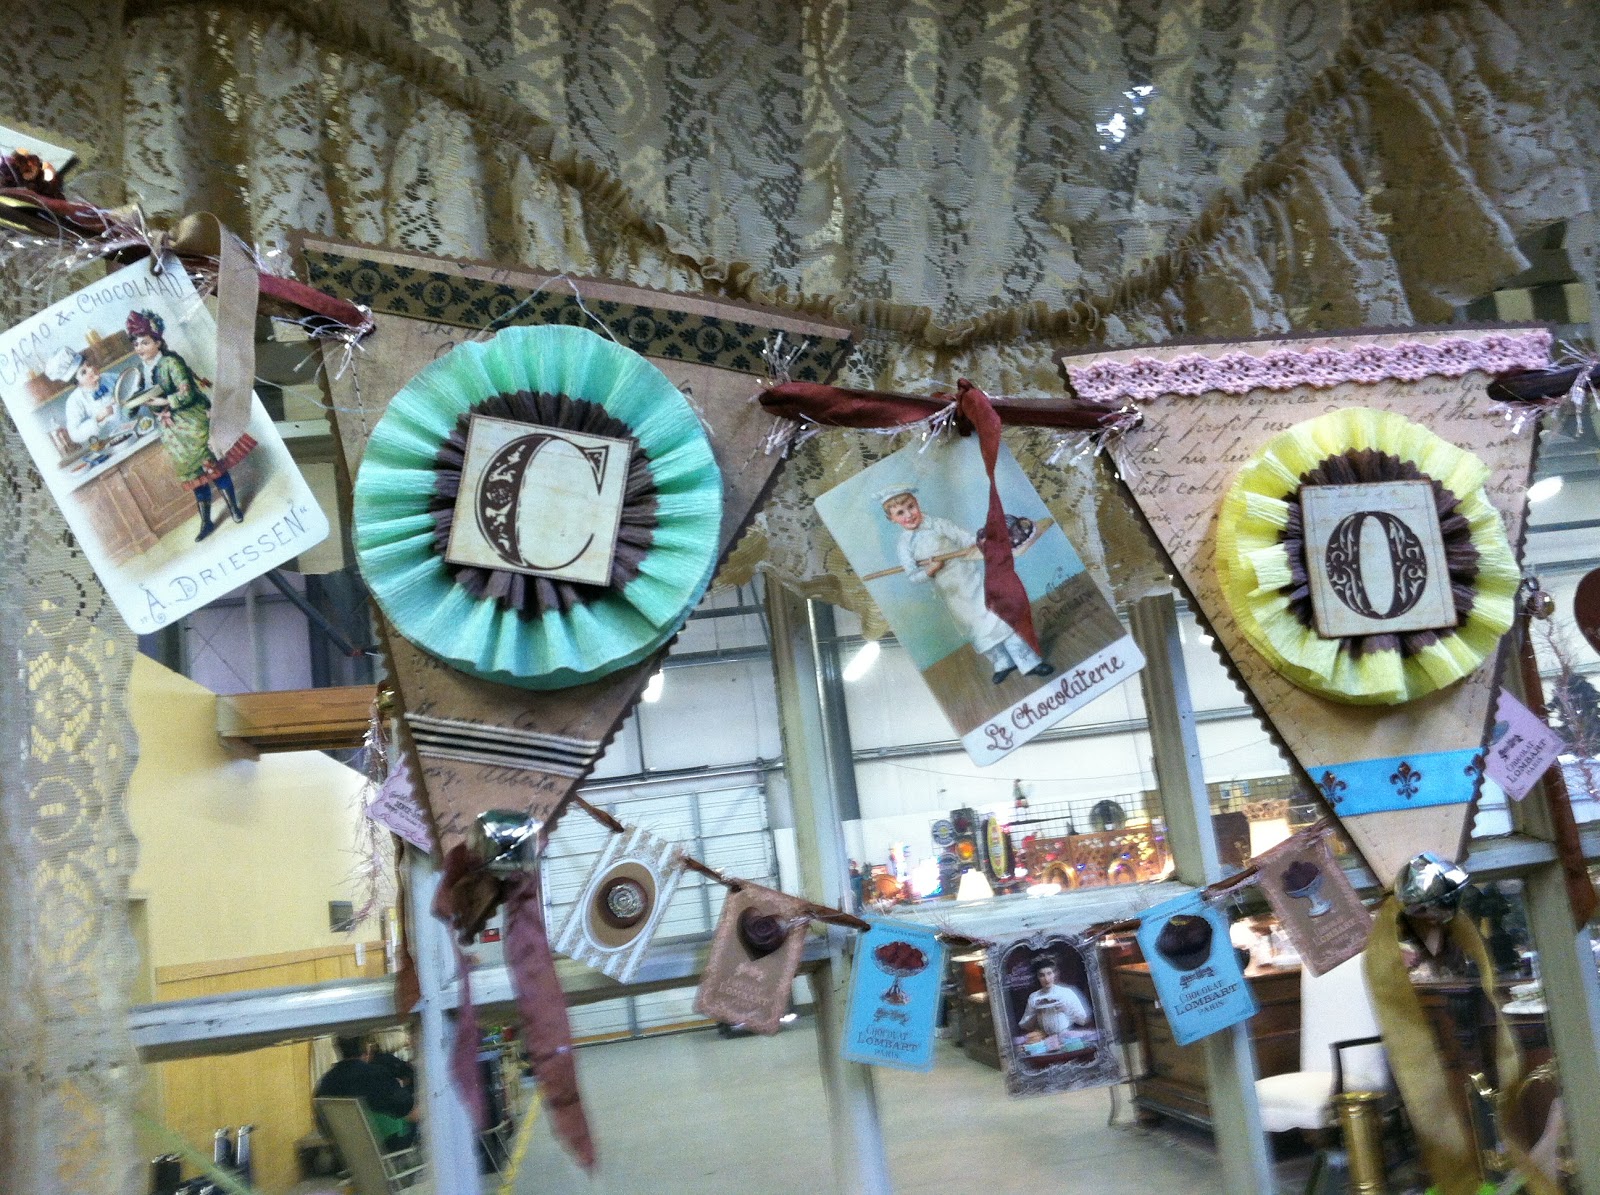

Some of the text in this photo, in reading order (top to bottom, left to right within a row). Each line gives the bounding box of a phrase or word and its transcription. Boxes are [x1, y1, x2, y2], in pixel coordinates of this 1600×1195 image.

[474, 433, 611, 571] C
[1324, 510, 1429, 619] O
[1010, 654, 1125, 730] Chocolaterie
[1506, 738, 1547, 783] LOMBART
[1174, 982, 1238, 1016] LOMBART
[857, 1031, 922, 1053] LOMBART
